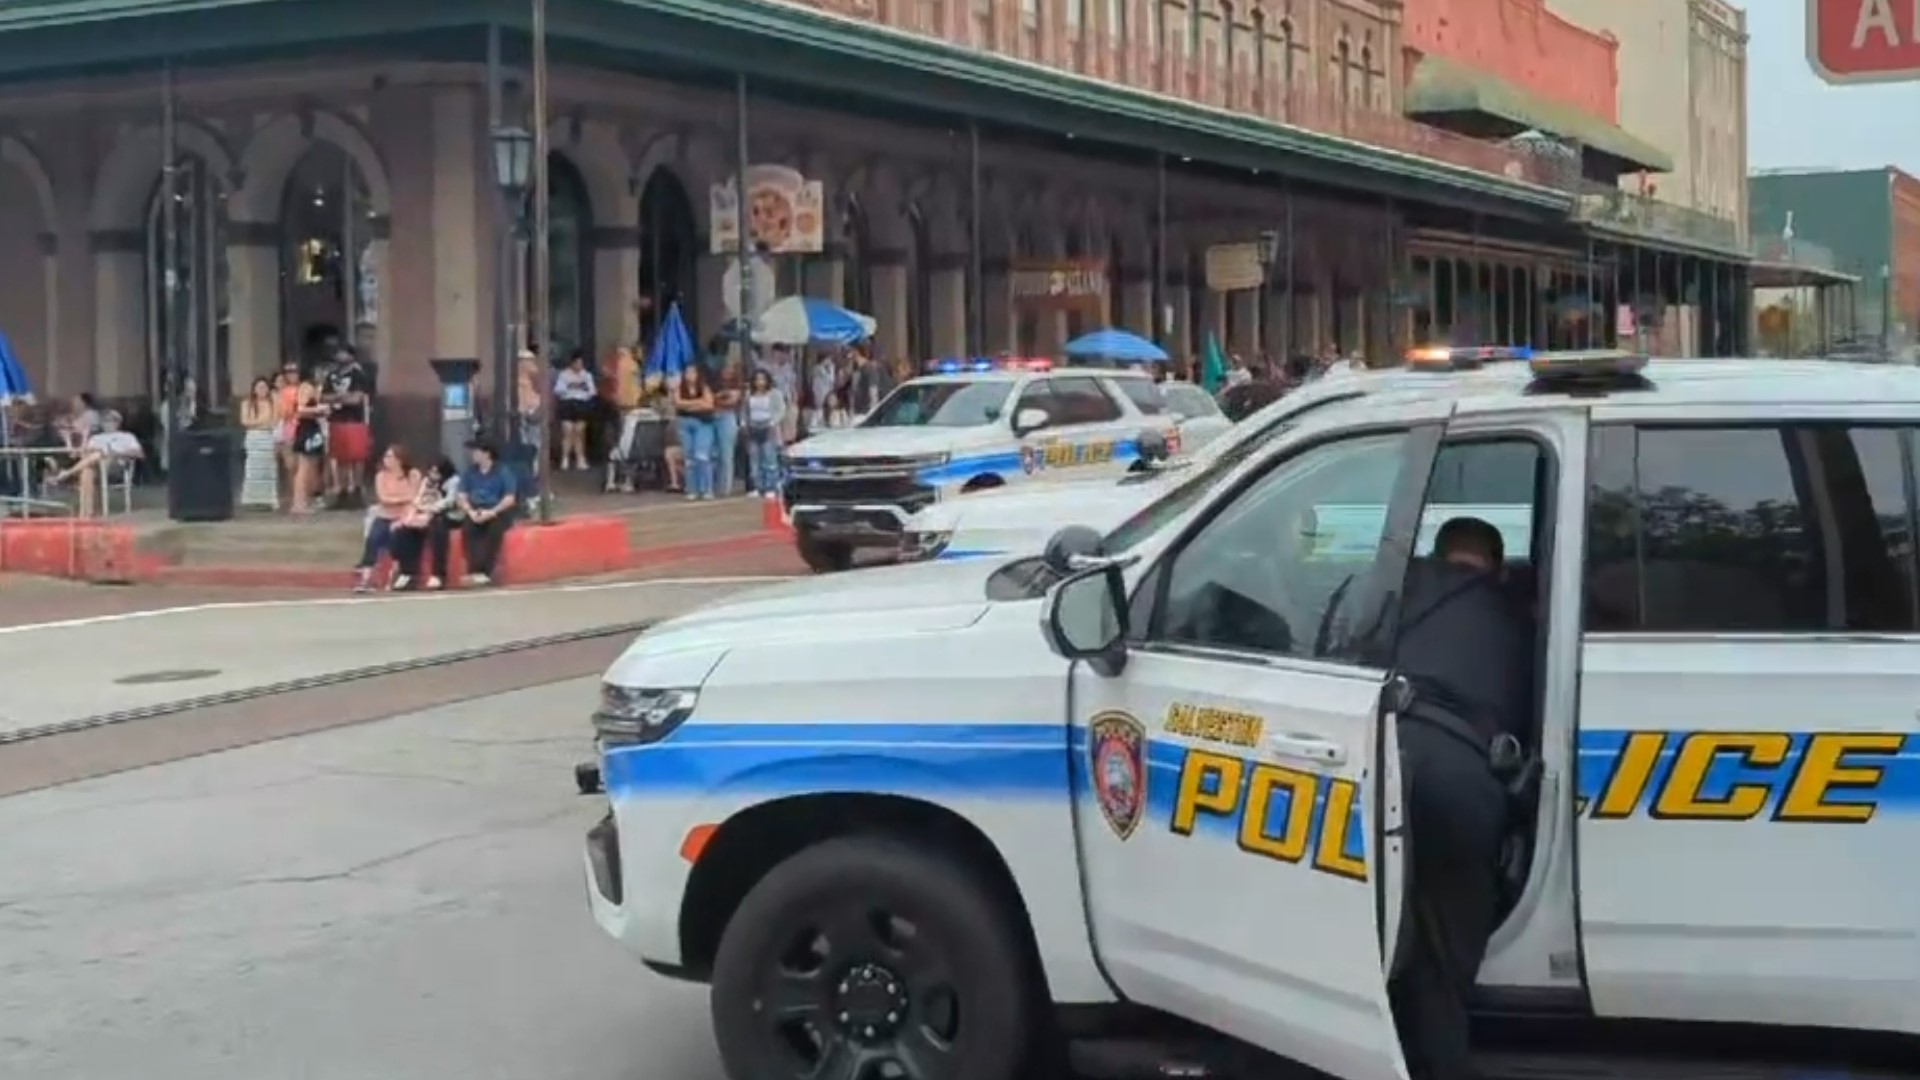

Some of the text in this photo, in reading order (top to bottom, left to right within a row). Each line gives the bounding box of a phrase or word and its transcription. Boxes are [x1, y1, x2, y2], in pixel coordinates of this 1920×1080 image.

[1850, 0, 1920, 48] A
[1169, 732, 1906, 883] POL ICE
